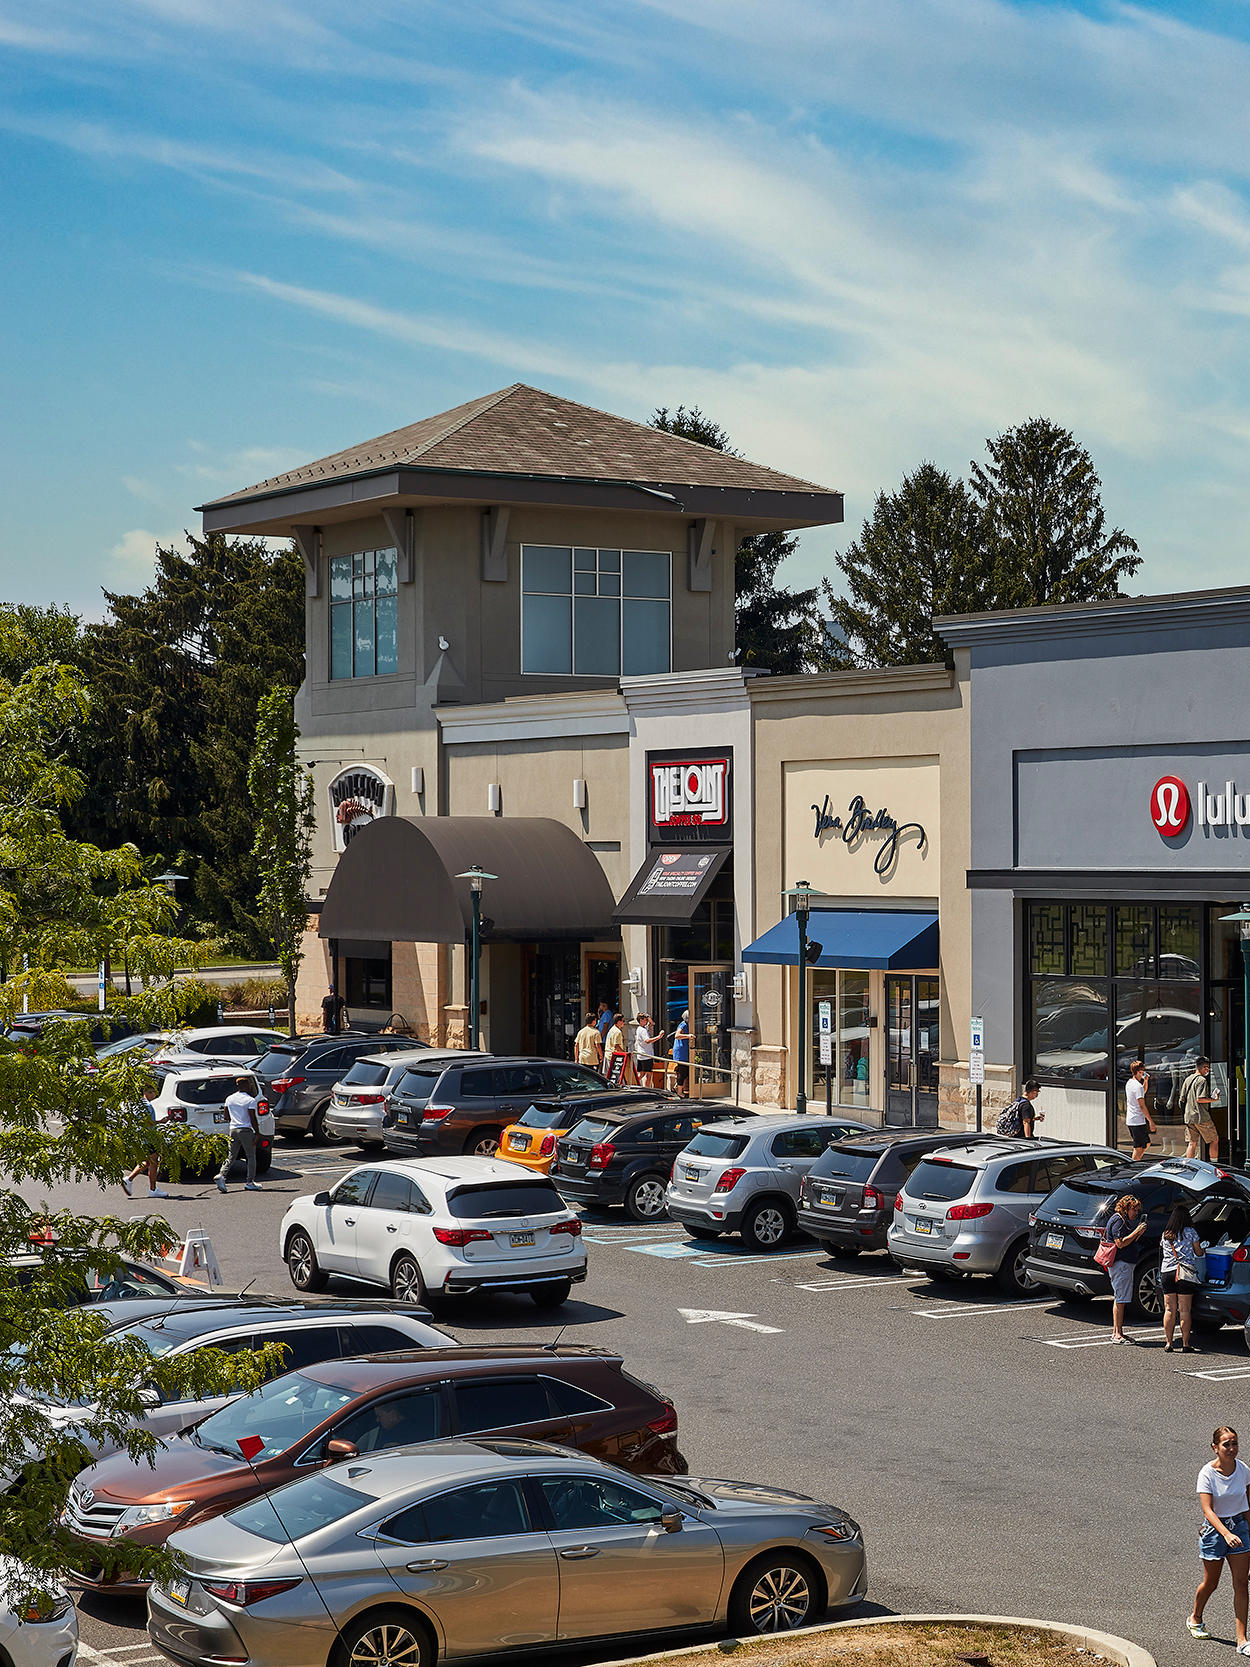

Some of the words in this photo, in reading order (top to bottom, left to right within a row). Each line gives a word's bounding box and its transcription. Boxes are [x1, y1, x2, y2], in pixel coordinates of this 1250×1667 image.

[672, 765, 724, 821] JOINT
[811, 794, 843, 838] Vera
[842, 795, 926, 874] Bradley
